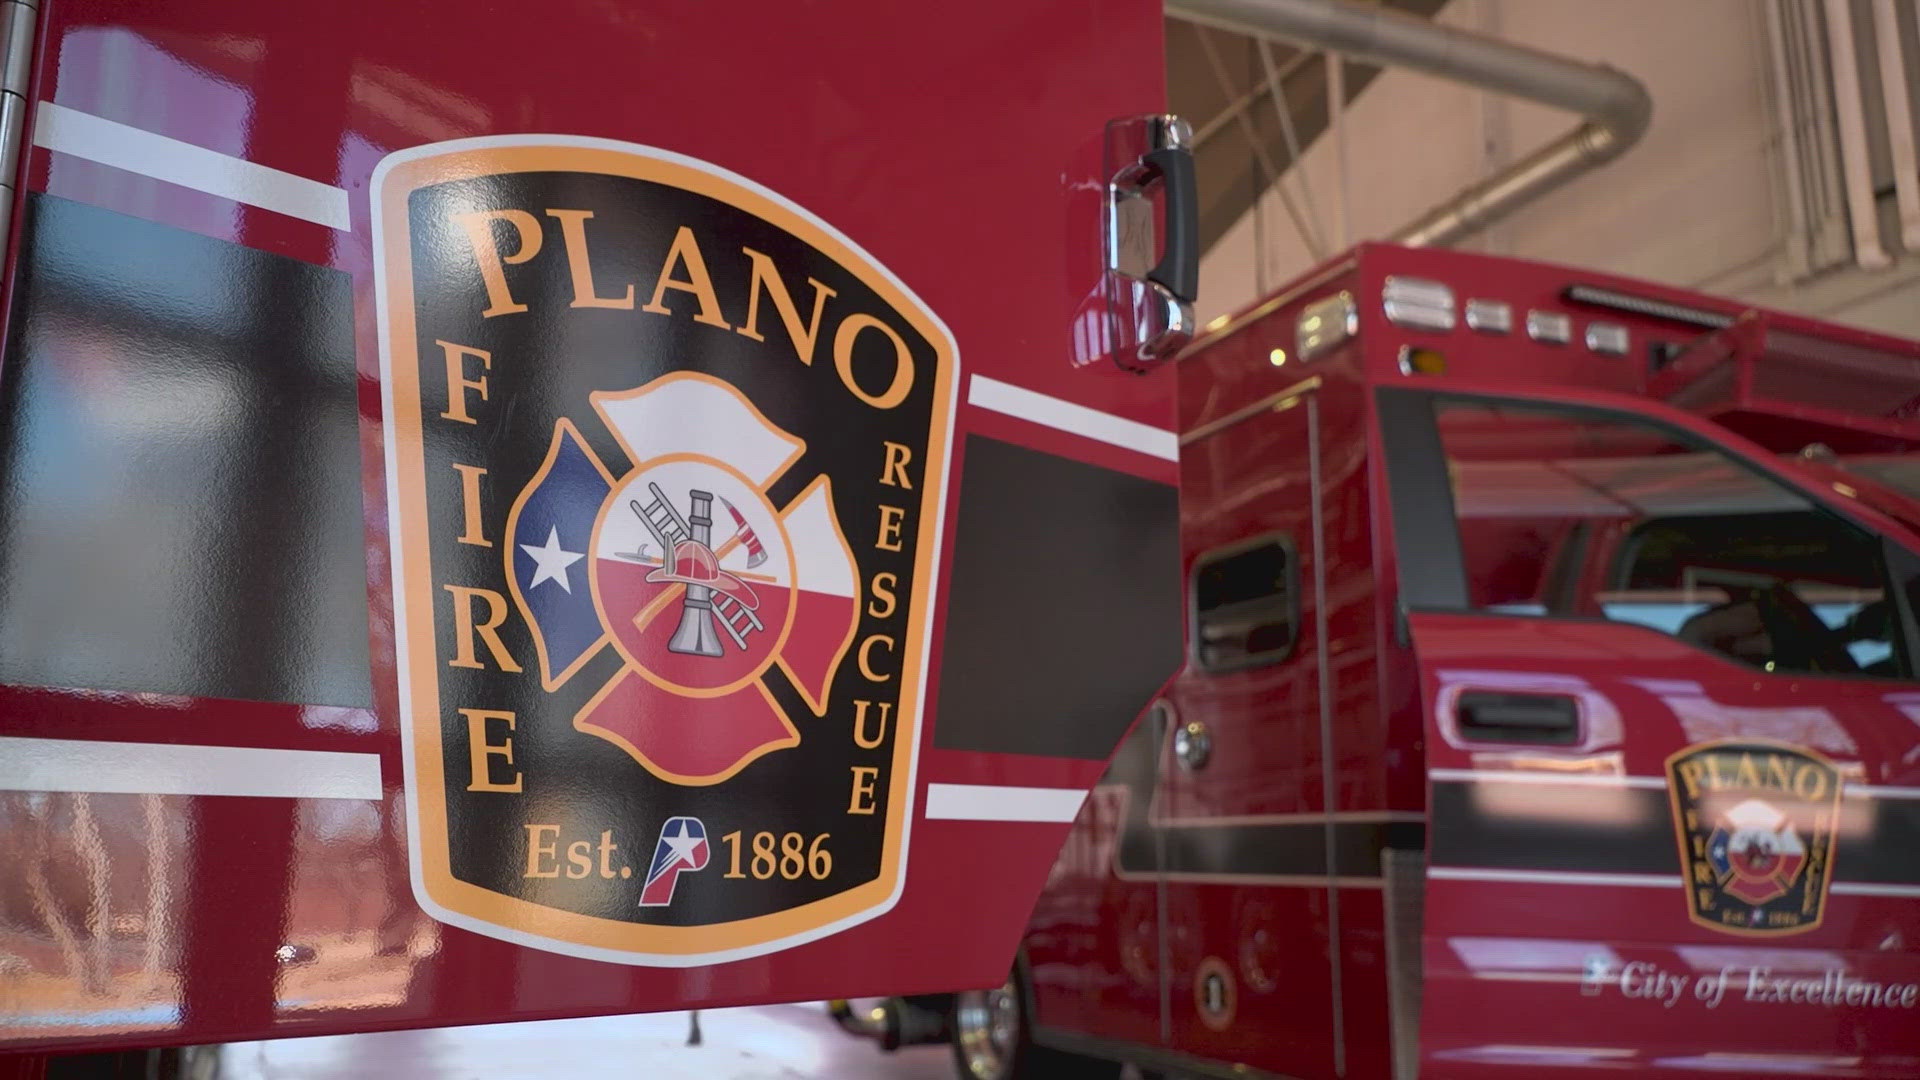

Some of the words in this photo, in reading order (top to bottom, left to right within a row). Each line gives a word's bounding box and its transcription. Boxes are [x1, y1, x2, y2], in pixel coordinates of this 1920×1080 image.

[448, 208, 915, 409] PLANO
[436, 339, 522, 793] FIRE
[847, 441, 913, 815] RESCUE
[1679, 752, 1828, 801] PLANO
[523, 824, 632, 880] Est.
[721, 830, 833, 881] 1886
[1620, 961, 1689, 1009] City
[1694, 964, 1734, 1009] of
[1744, 966, 1919, 1008] Excellence
